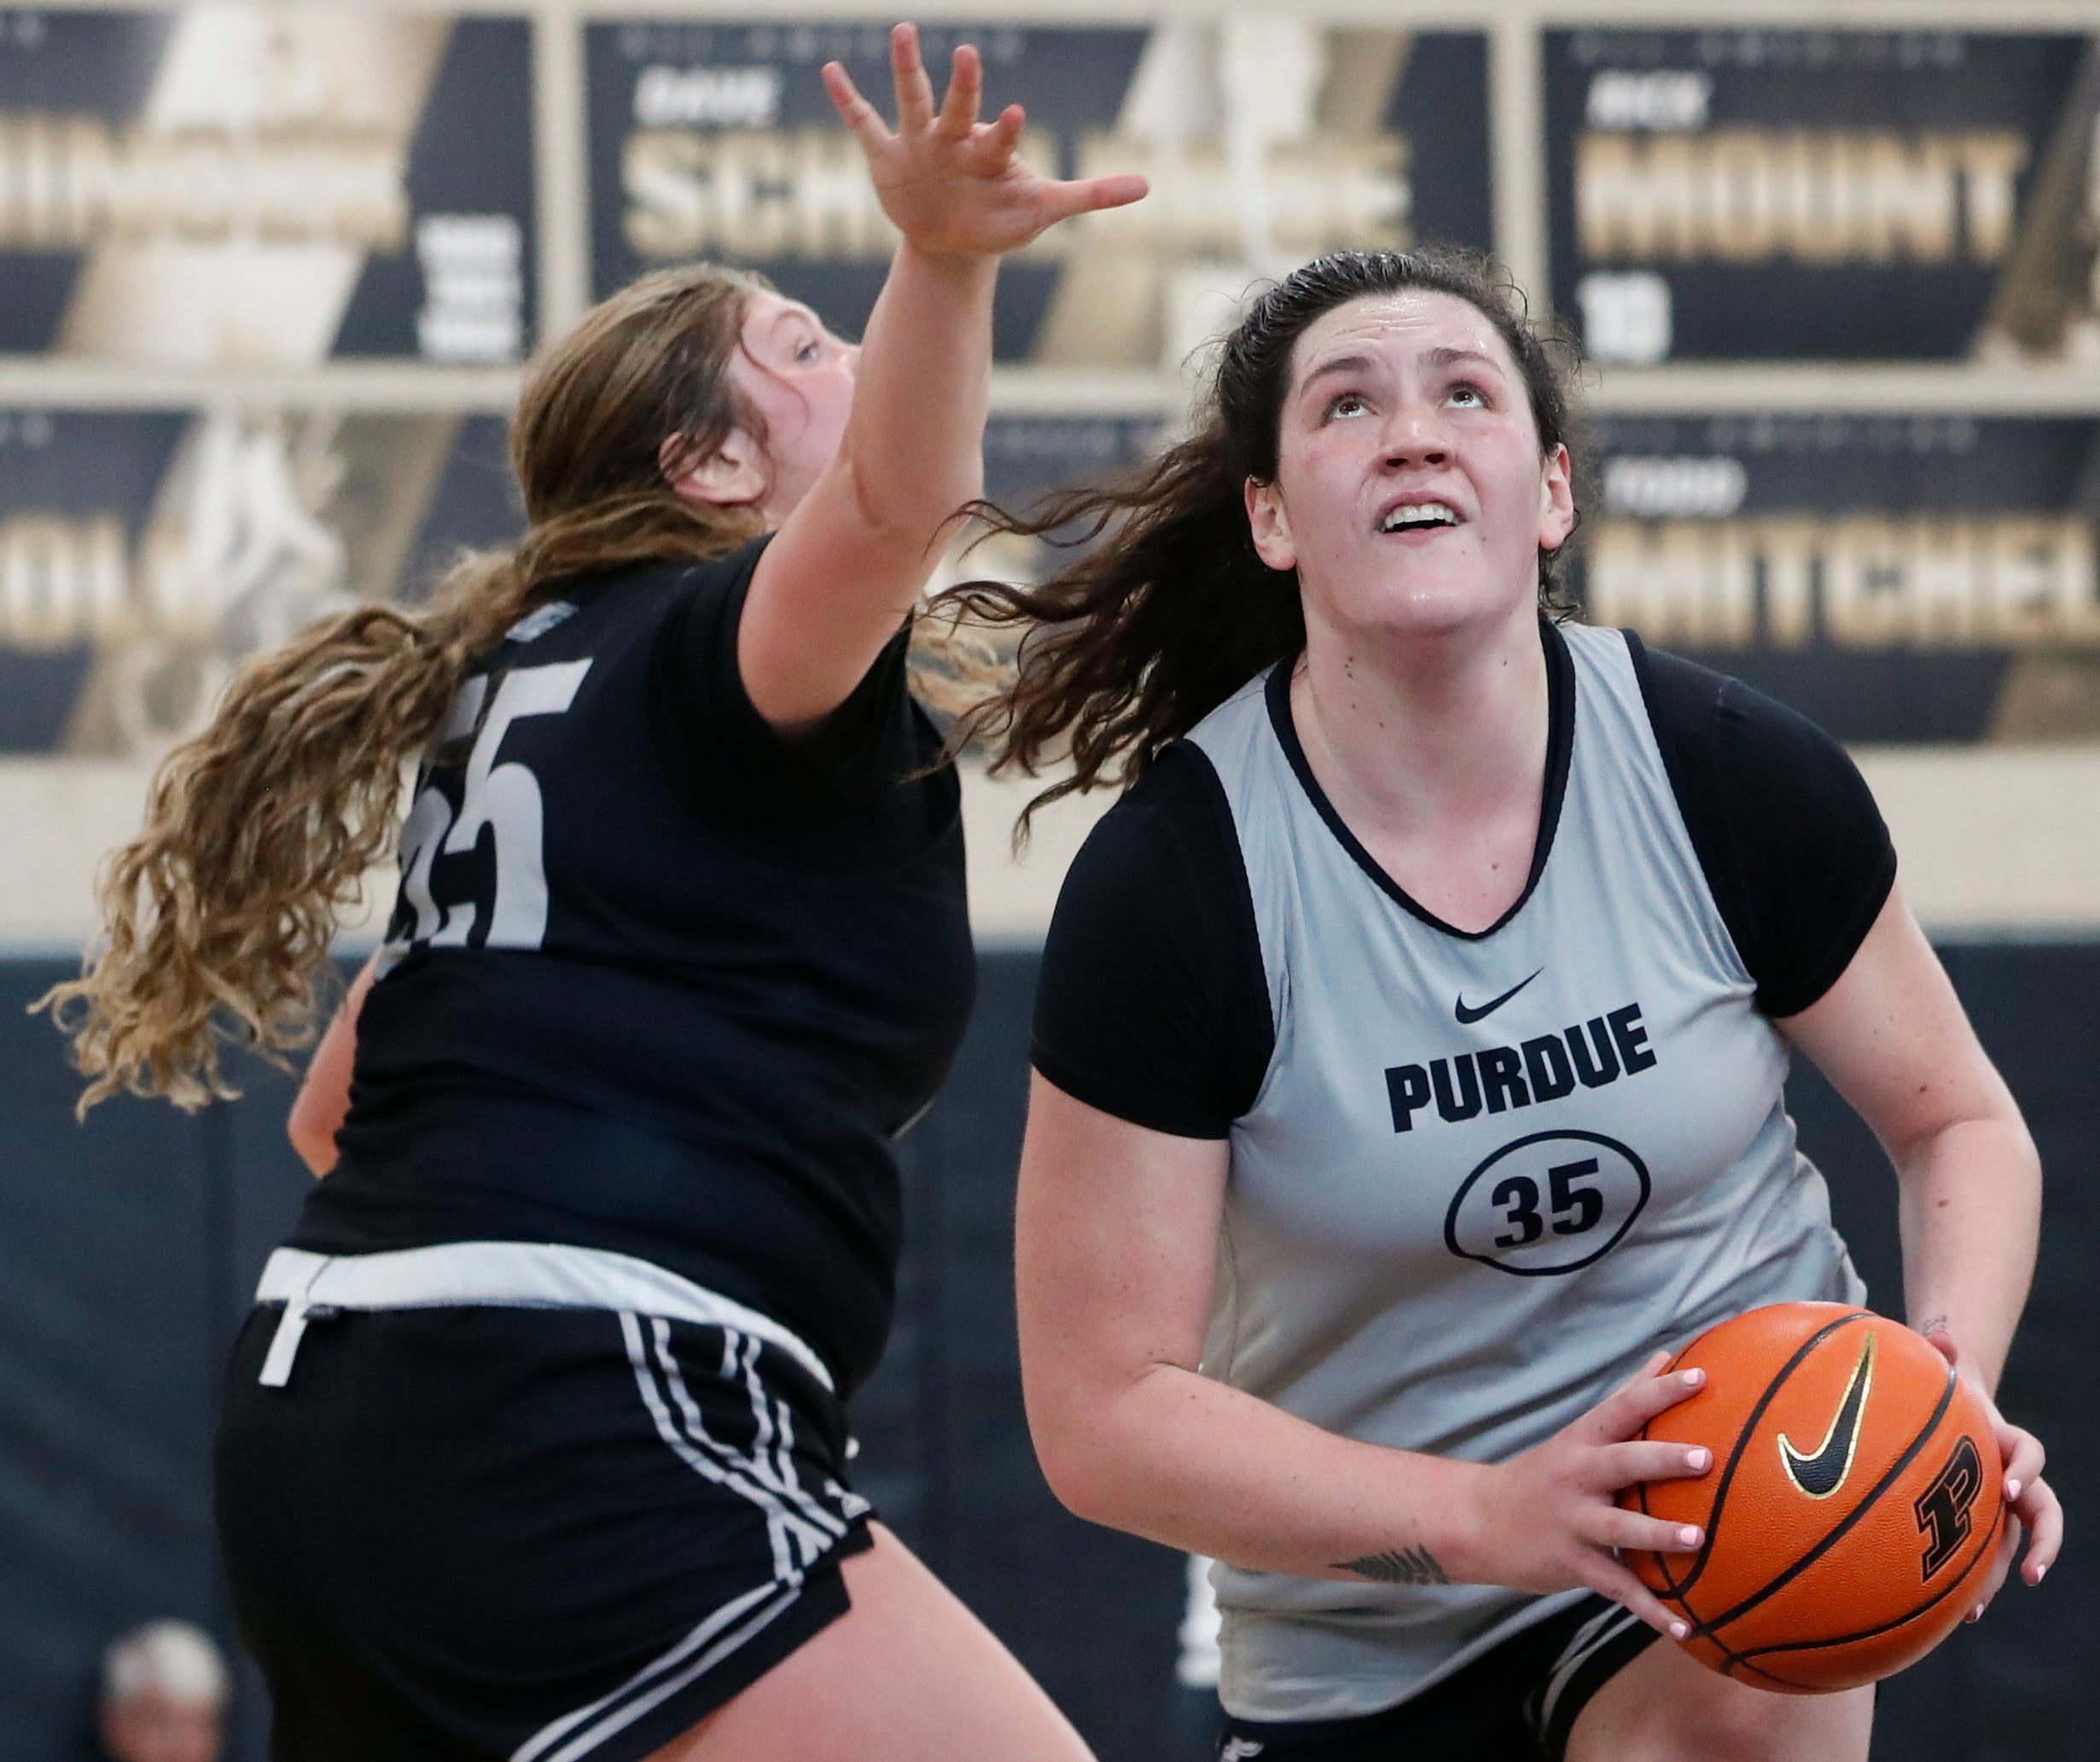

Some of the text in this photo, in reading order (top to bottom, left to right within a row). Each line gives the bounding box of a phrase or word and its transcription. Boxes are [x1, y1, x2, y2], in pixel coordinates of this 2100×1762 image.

[1574, 130, 2027, 263] MOUNT
[1385, 1003, 1657, 1133] PURDUE
[1492, 1158, 1603, 1247] 35
[1913, 1434, 1984, 1583] P
